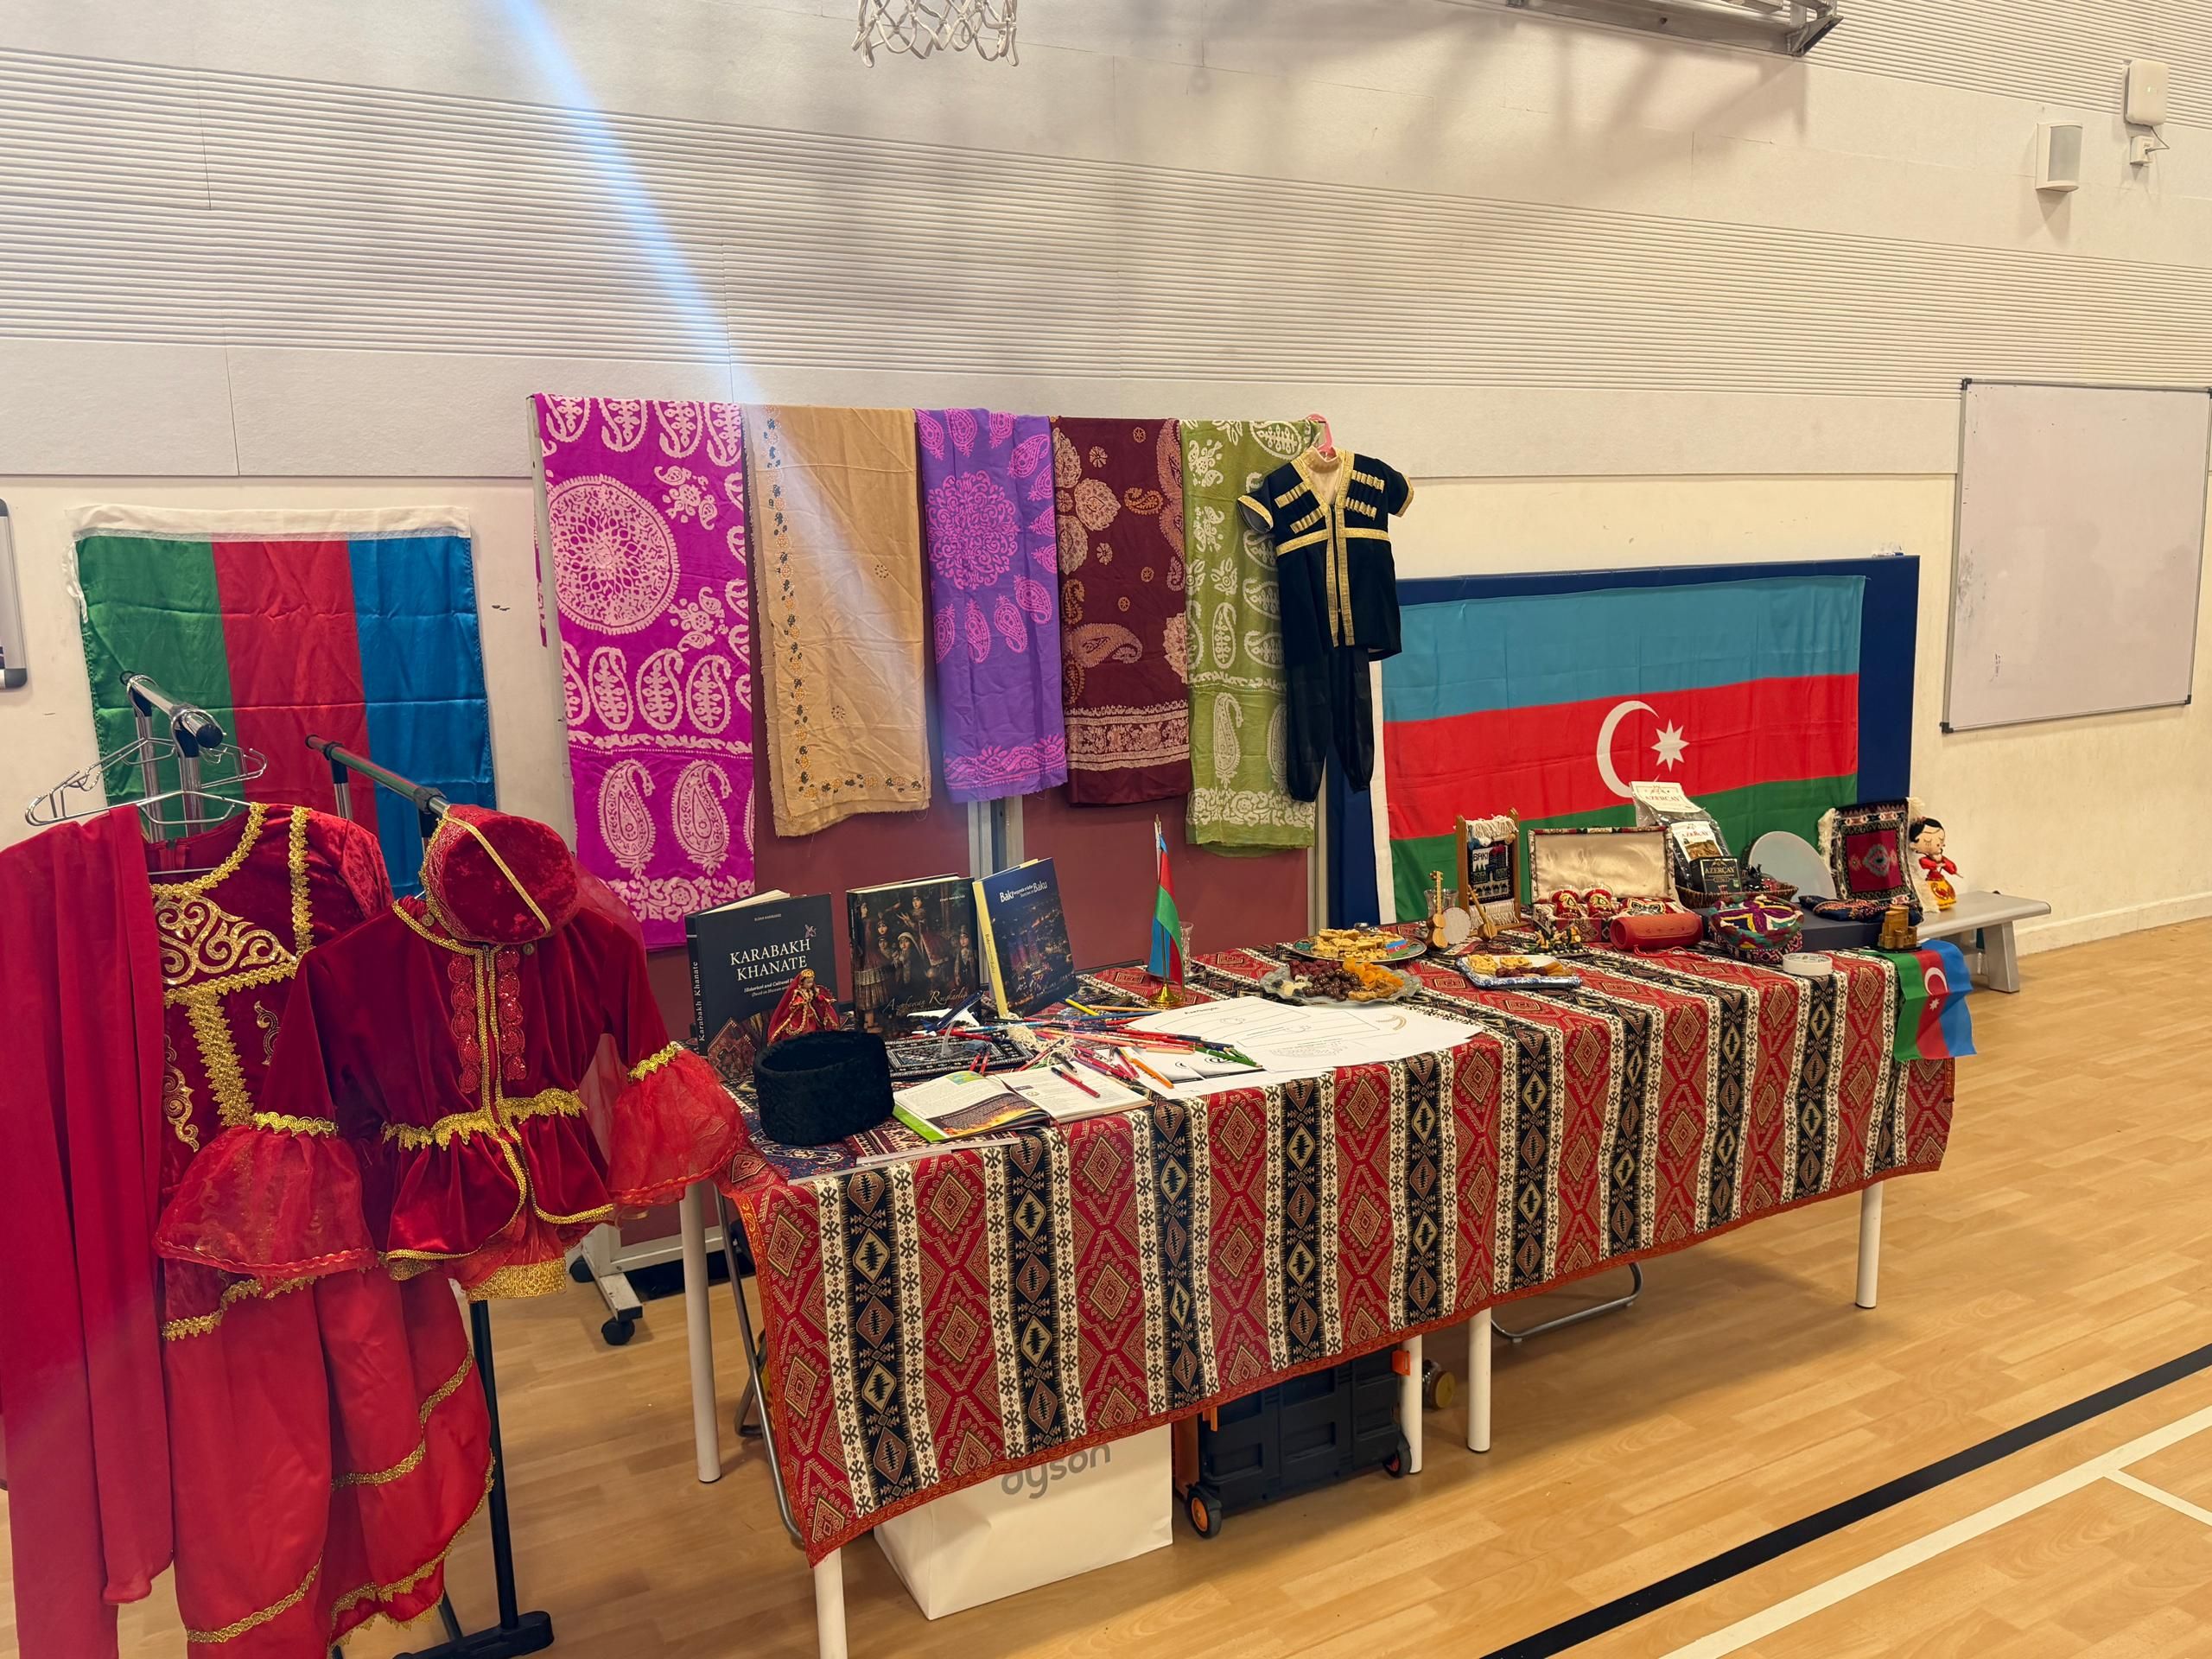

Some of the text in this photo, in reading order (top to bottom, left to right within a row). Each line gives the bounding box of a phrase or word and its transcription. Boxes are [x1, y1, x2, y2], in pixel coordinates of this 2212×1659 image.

[729, 938, 811, 966] KARABAKH
[737, 955, 808, 982] KHANATE
[692, 961, 706, 1042] Karabakh Khanate
